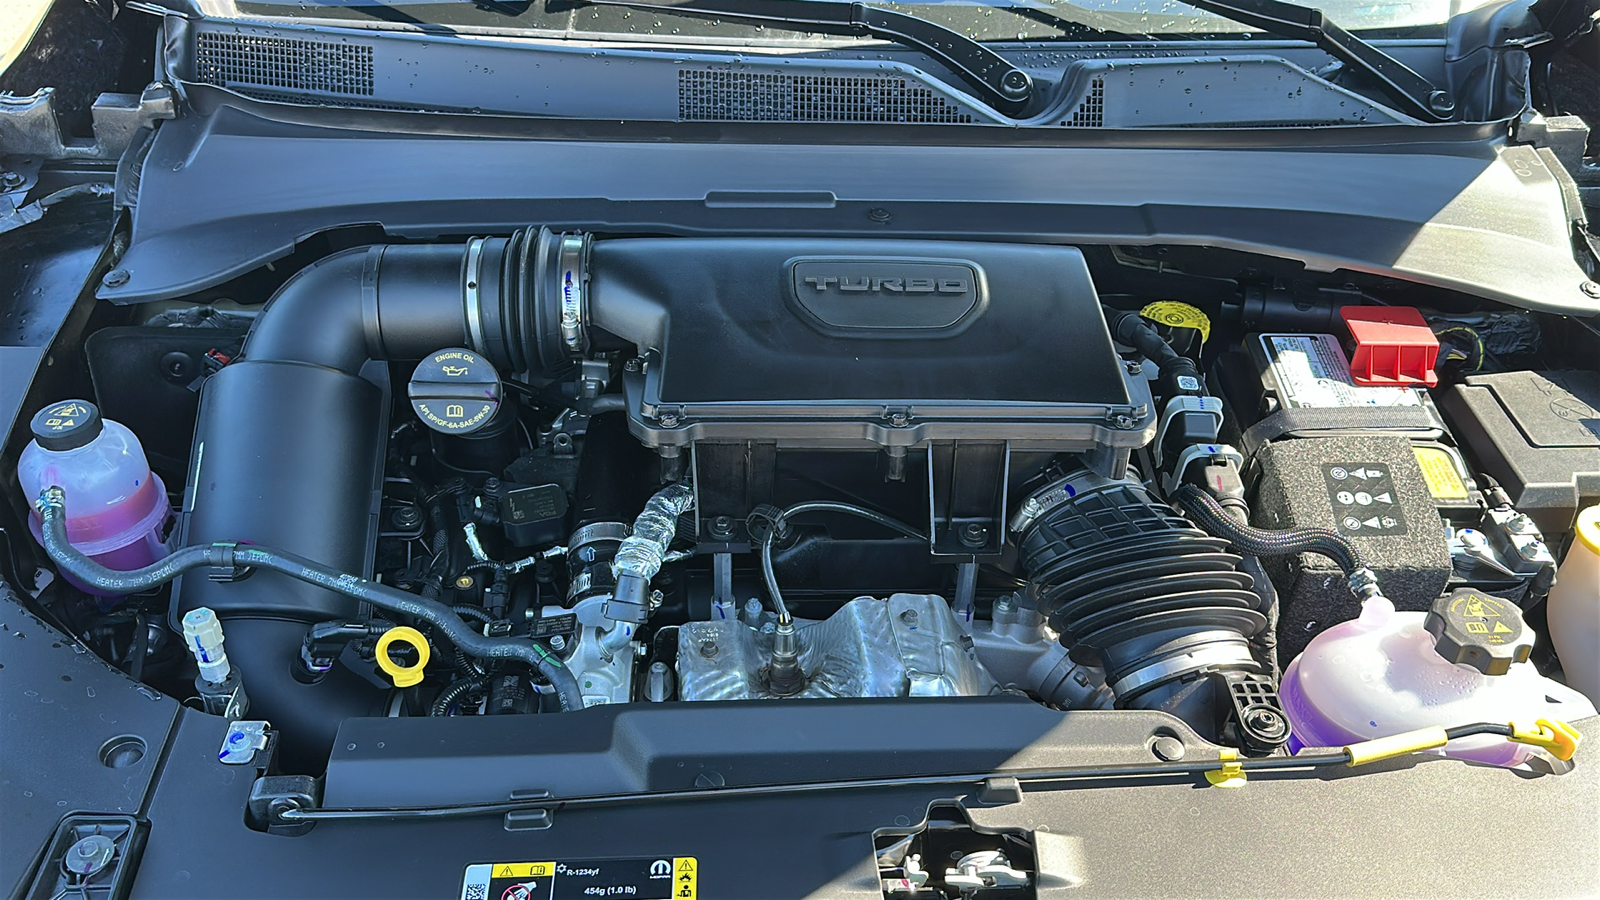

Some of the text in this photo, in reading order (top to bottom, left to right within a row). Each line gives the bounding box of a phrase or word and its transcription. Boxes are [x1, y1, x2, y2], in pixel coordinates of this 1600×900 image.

[805, 276, 967, 293] TURBO
[435, 352, 474, 364] ENGINE OIL
[419, 404, 428, 416] API
[302, 567, 325, 583] HEATER
[96, 576, 124, 589] HEATER
[566, 867, 599, 877] R-1234yf
[584, 886, 636, 896] 454g (1.0 lb)
